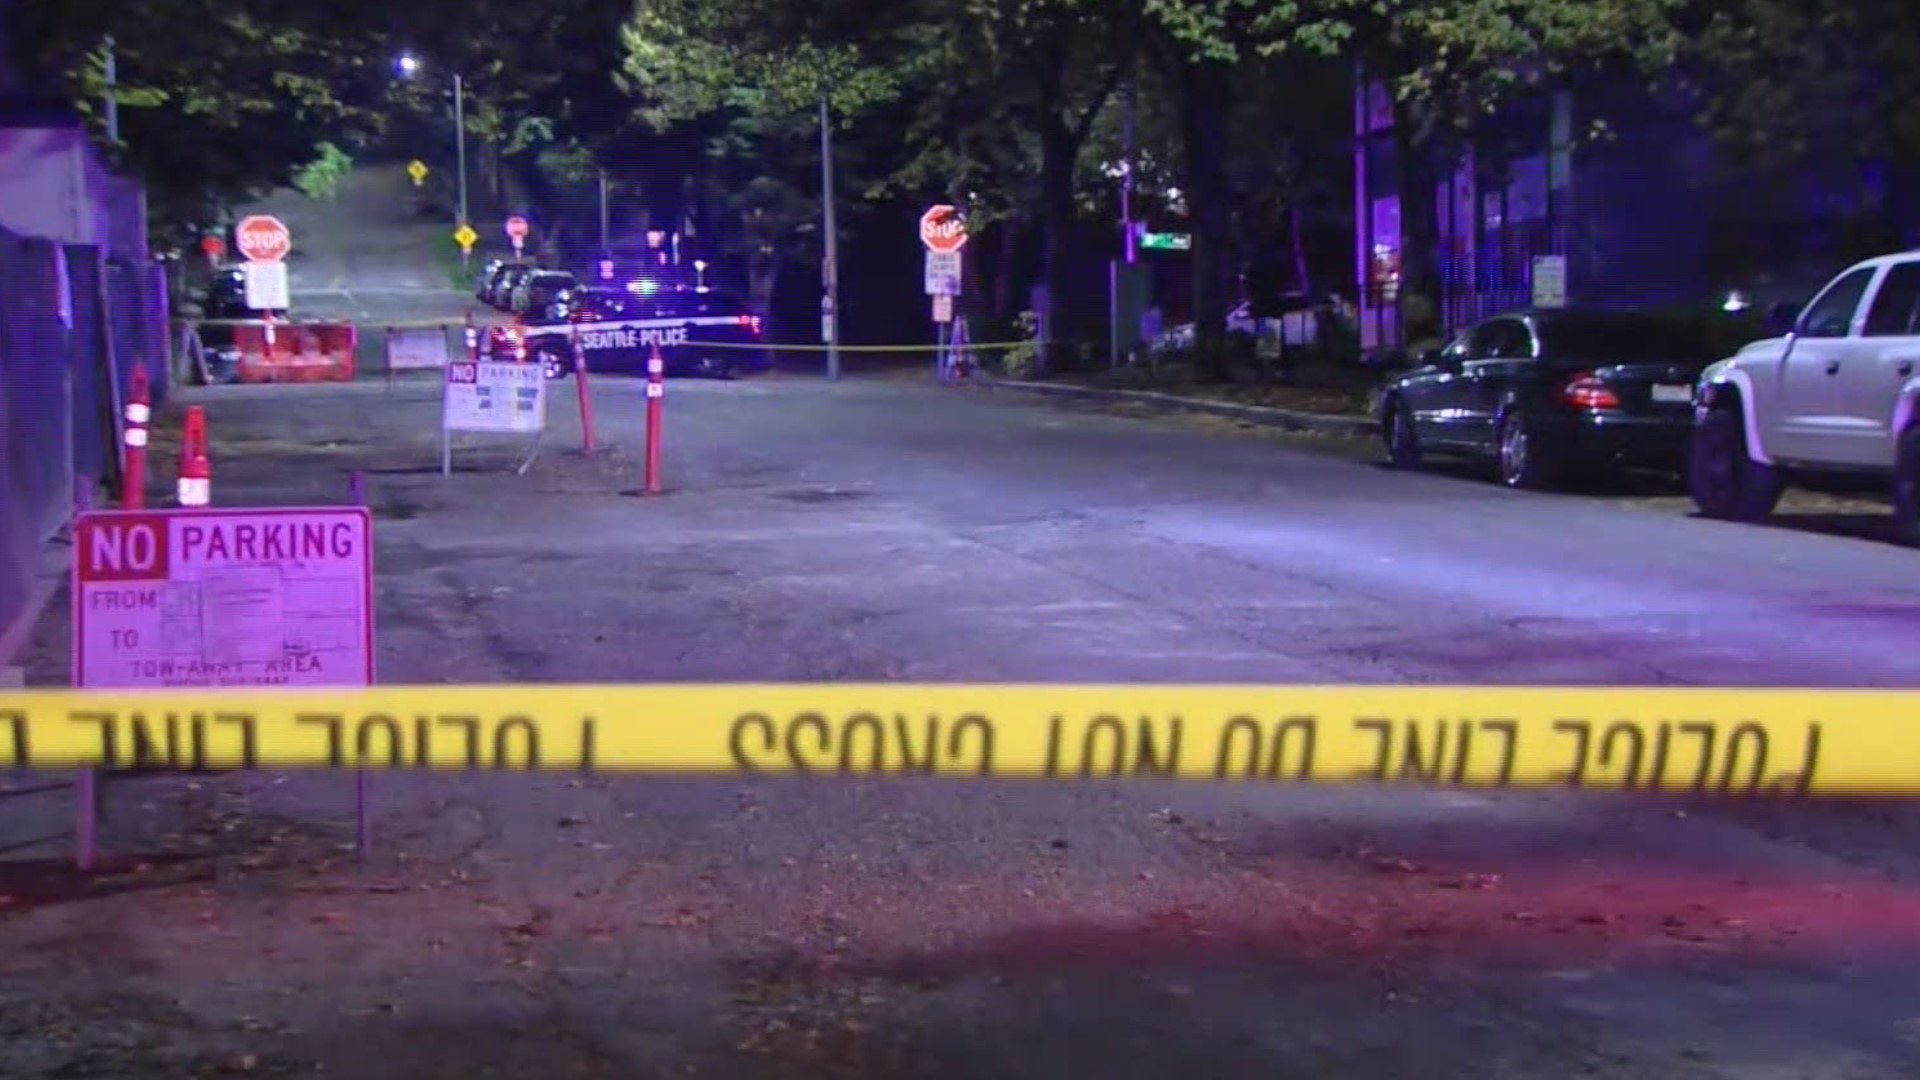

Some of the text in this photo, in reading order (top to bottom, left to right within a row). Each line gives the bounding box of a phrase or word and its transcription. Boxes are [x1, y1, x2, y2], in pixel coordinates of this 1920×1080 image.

[242, 230, 285, 249] STOP
[583, 327, 688, 349] SEATTLE POLICE
[451, 363, 538, 382] NO PARKING
[91, 522, 353, 572] NO PARKING
[91, 590, 157, 611] FROM
[110, 629, 139, 649] TO
[264, 655, 323, 673] AREA
[1551, 719, 1821, 798] POLICE
